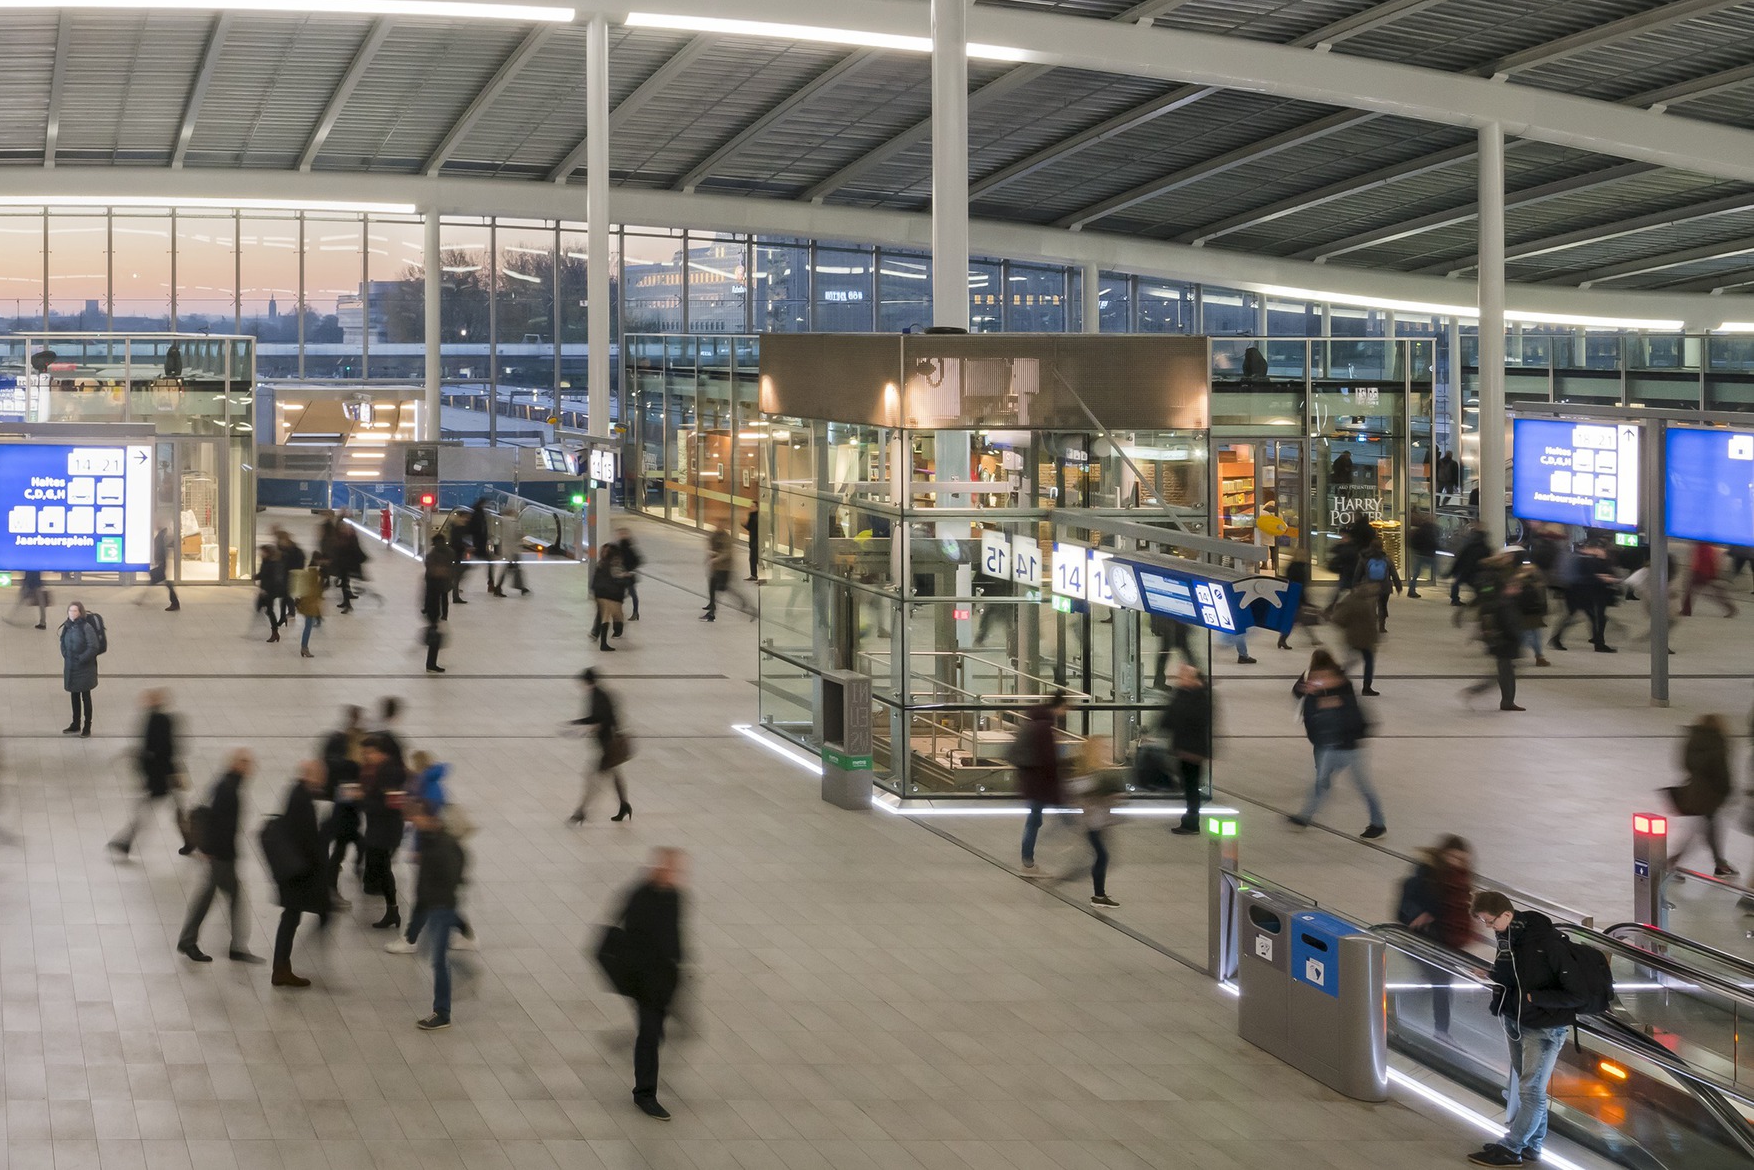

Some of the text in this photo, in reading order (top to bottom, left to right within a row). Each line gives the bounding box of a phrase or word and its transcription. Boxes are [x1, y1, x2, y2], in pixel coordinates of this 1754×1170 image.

[74, 459, 119, 472] 14 21
[30, 476, 66, 488] Haltes
[24, 488, 66, 500] C,D,G,H
[1334, 496, 1383, 511] HARRY
[15, 535, 95, 548] Jaarbeursplein
[1058, 563, 1082, 593] 14
